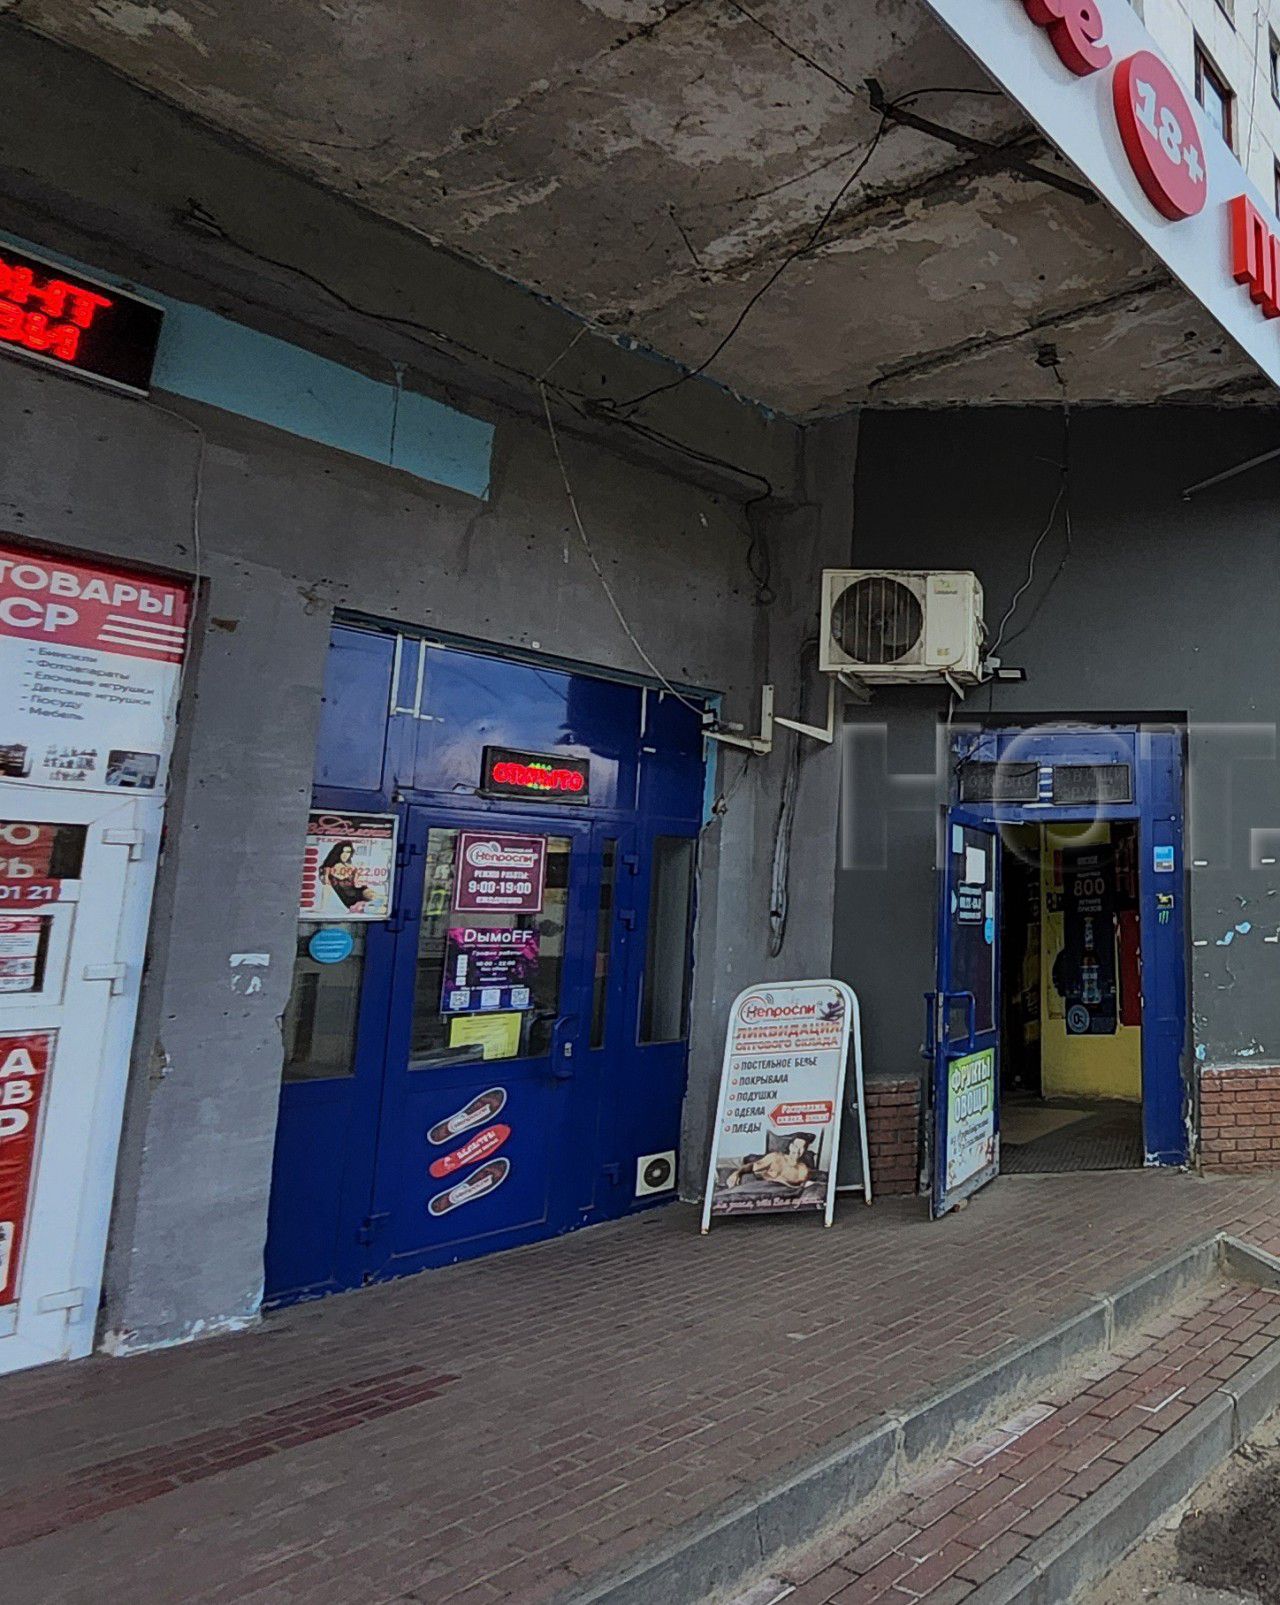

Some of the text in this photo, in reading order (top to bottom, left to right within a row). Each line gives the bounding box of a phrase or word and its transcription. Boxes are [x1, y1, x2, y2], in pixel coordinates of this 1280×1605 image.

[1136, 78, 1204, 184] 18+
[493, 762, 584, 791] ОТКРЫТО
[27, 885, 54, 900] 21
[468, 880, 532, 894] 9:00-19:00
[1074, 878, 1105, 896] 800
[464, 929, 533, 943] DымоFF
[735, 1022, 843, 1039] ЛИКВИДАЦИЯ
[741, 1058, 792, 1070] ПОСТЕЛЬНОЕ
[738, 1073, 788, 1086] ПОКРЫВАЛА
[951, 1055, 992, 1094] ФРУКТЫ
[737, 1090, 778, 1102] ПОДУШКИ
[954, 1084, 988, 1122] ОВОЩИ
[734, 1106, 765, 1118] ОДЕЯЛА
[731, 1122, 762, 1134] ПЛЕДЫ
